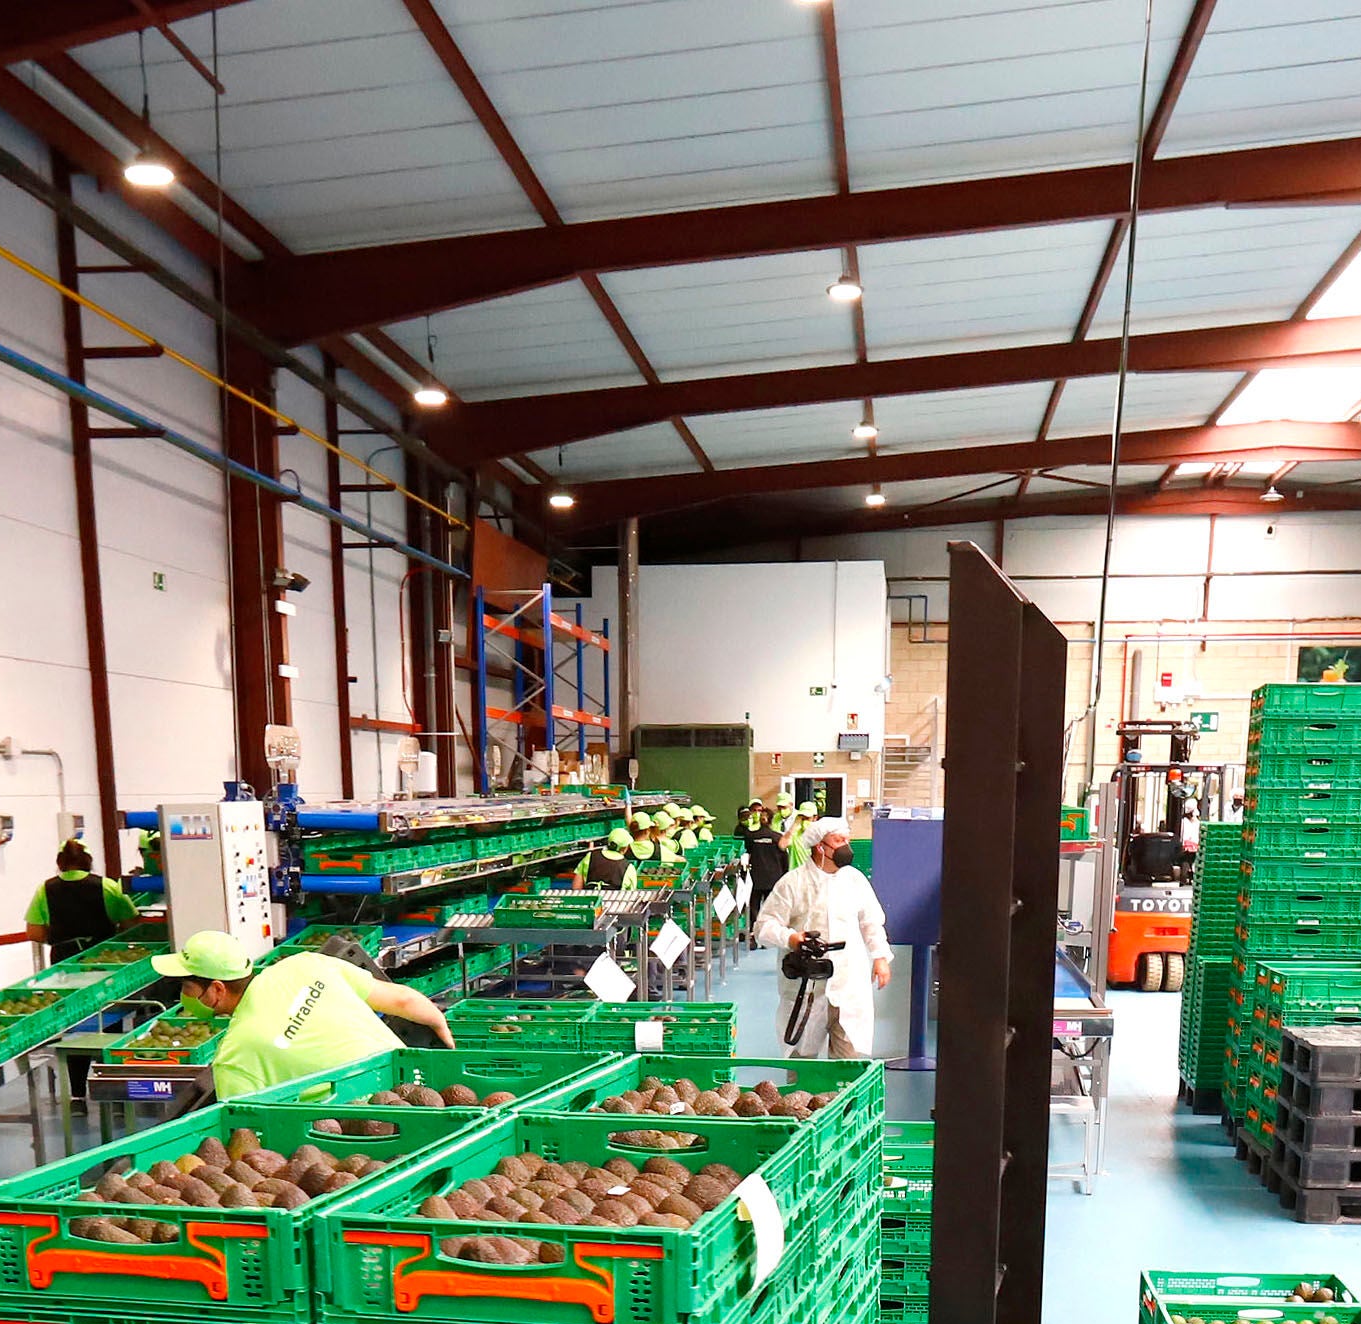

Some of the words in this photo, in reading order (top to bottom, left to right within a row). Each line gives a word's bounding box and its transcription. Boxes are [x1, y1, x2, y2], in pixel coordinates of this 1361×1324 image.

[1130, 898, 1193, 912] TOYOT
[283, 979, 327, 1041] miranda
[1066, 1020, 1083, 1033] MH
[153, 1081, 173, 1095] MH
